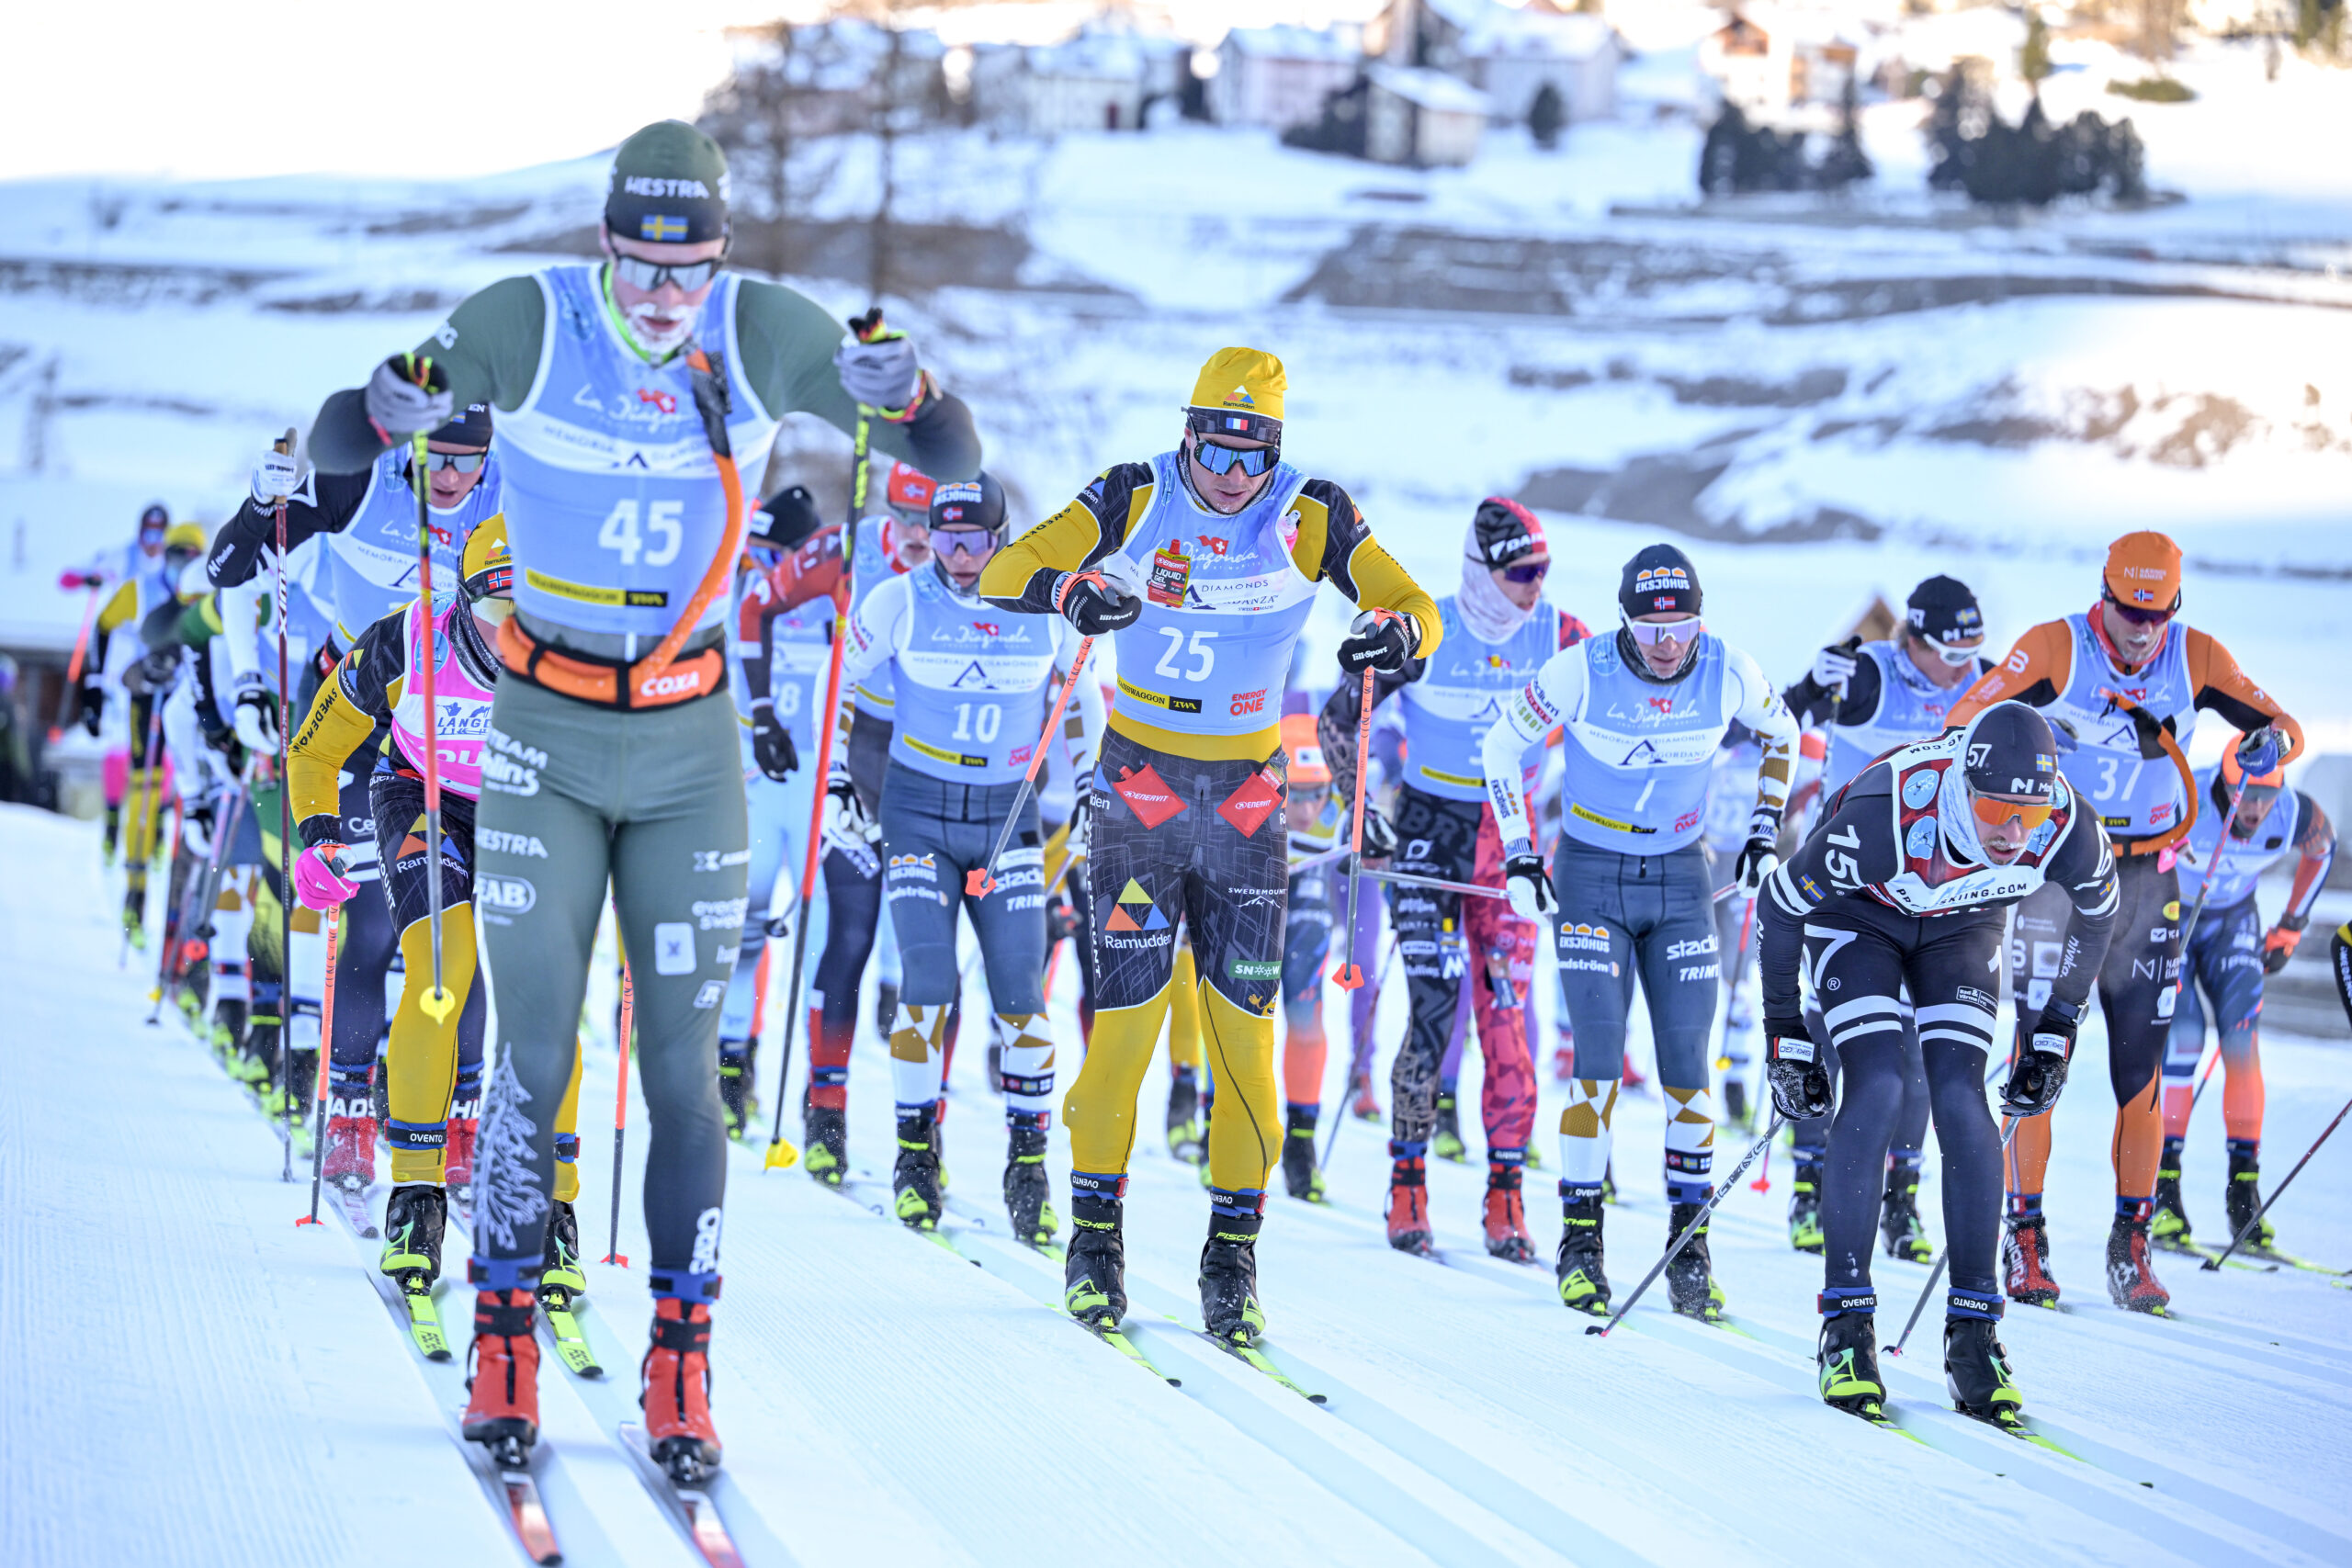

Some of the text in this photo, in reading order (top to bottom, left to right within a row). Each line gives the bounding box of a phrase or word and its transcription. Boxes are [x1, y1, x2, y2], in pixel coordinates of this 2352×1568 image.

[625, 175, 709, 199] HESTRA
[1223, 401, 1255, 411] Ramudden
[598, 499, 684, 567] 45
[1154, 575, 1165, 583] GEL
[1156, 568, 1182, 580] LIQUID
[1202, 580, 1268, 592] DIAMONDS
[1635, 577, 1690, 593] EKSJÖHUS
[1155, 626, 1218, 682] 25
[640, 671, 699, 696] COXA
[1232, 688, 1268, 701] ENERGY
[1230, 698, 1264, 716] ONE
[1607, 702, 1626, 719] La
[952, 703, 1001, 743] 10
[2093, 756, 2144, 801] 37
[397, 855, 469, 879] Ramdden
[1104, 933, 1172, 950] Ramudden
[410, 1133, 443, 1144] OVENTO
[1072, 1176, 1099, 1188] OVENTO
[1842, 1296, 1874, 1309] OVENTO
[1953, 1296, 1988, 1312] OVENTO
